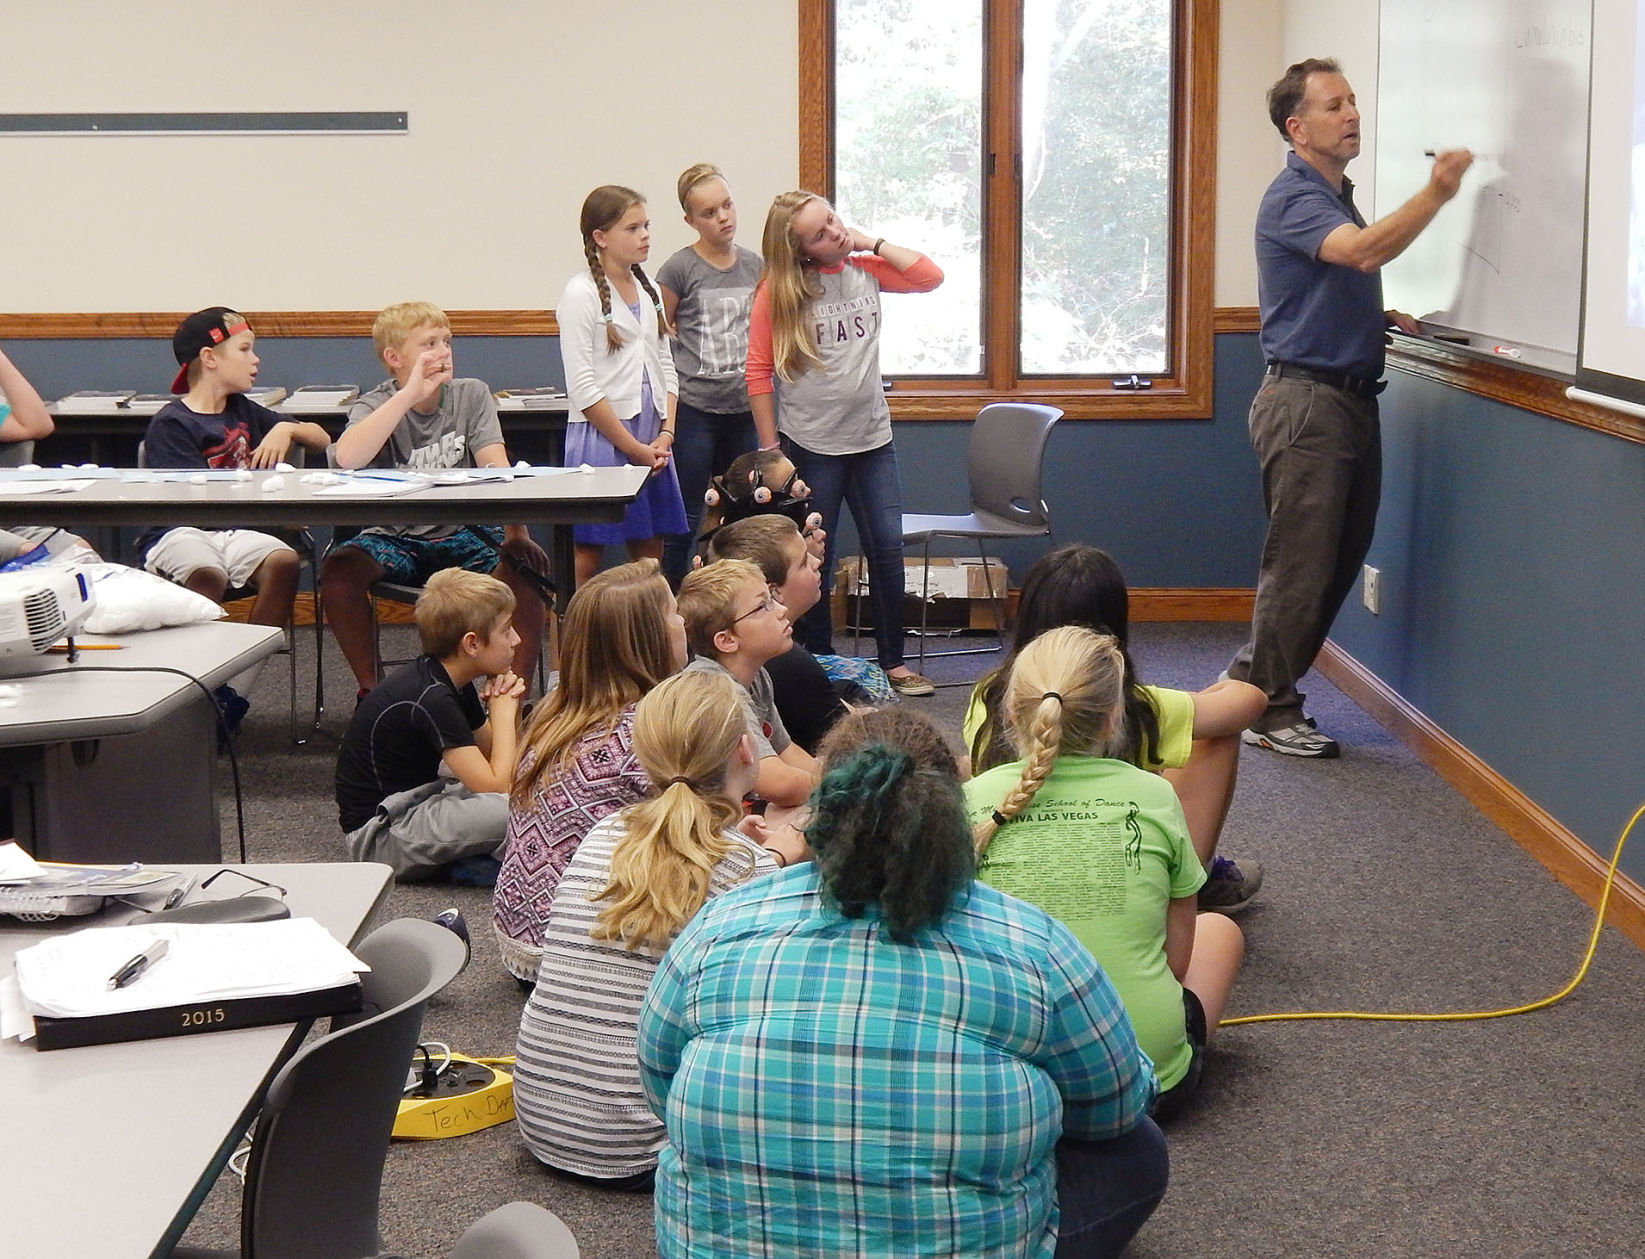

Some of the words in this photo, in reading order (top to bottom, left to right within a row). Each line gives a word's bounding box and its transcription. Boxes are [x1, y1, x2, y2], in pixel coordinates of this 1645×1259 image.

[815, 311, 878, 345] FAST
[1045, 798, 1078, 808] School
[1081, 798, 1092, 809] of
[1095, 798, 1125, 808] Dance
[1037, 813, 1058, 822] LAS
[1061, 812, 1098, 821] VEGAS
[181, 1008, 225, 1027] 2015
[422, 1104, 478, 1133] Tech
